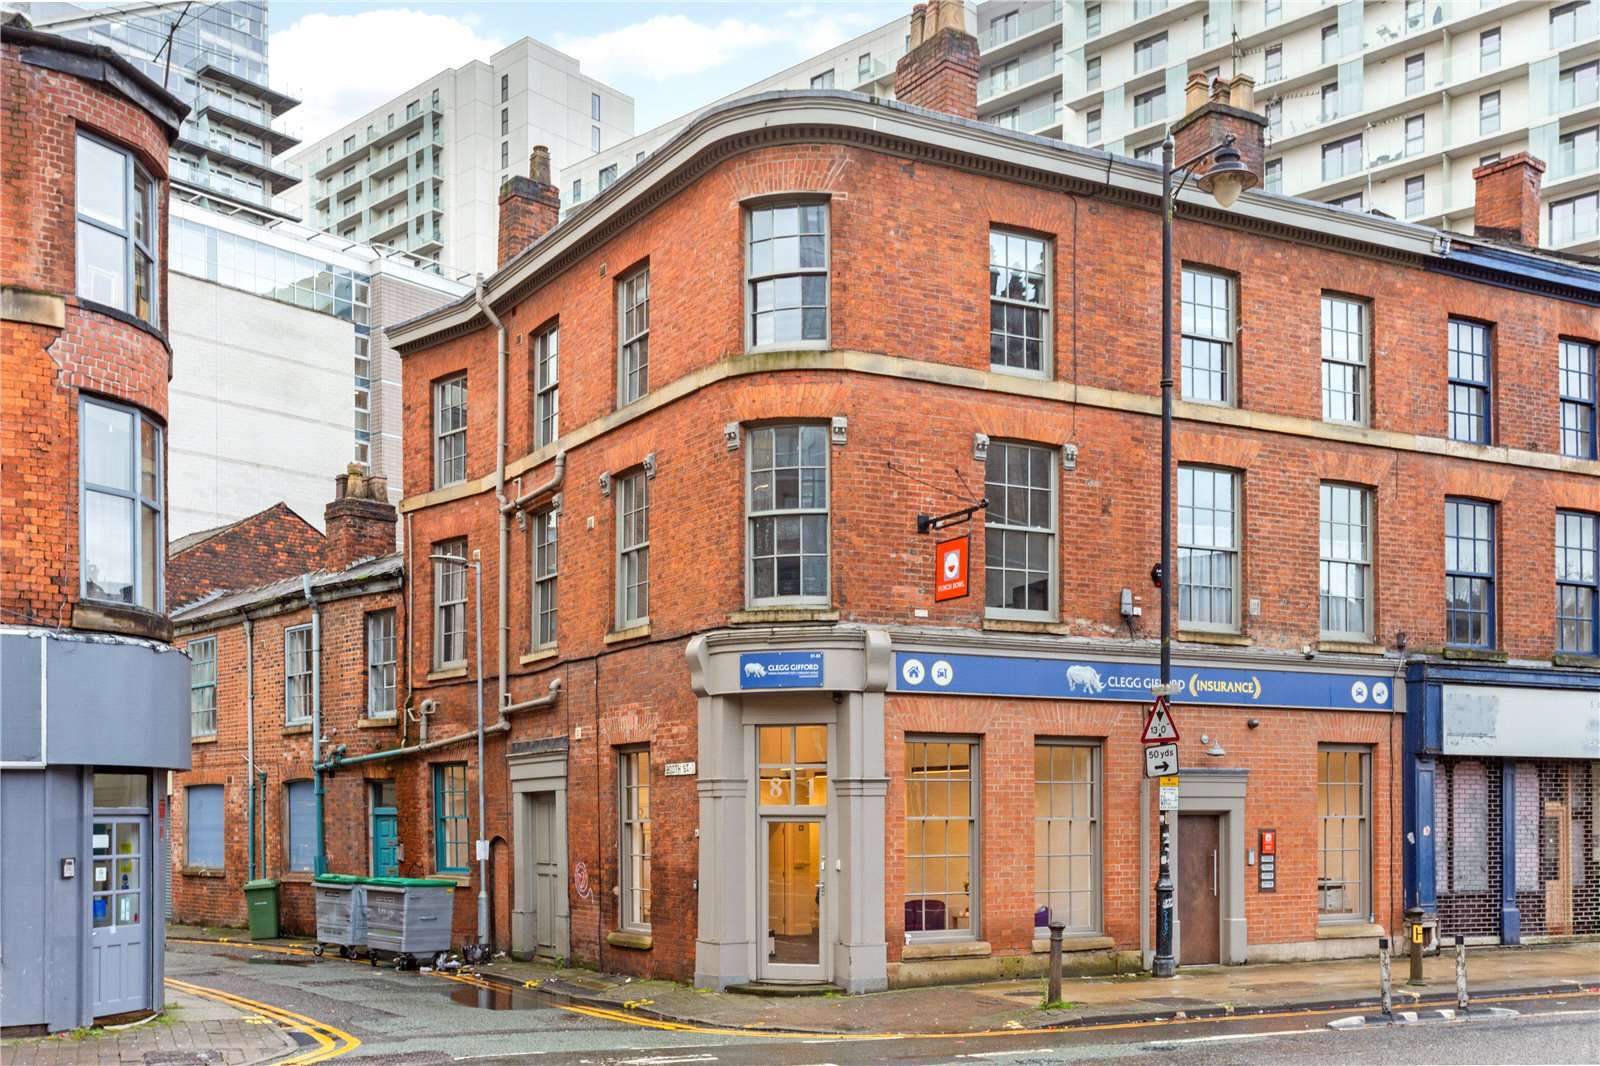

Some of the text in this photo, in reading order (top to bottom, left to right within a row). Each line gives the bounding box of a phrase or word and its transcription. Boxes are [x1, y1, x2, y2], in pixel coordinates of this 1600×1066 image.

[767, 663, 819, 671] CLEGG GIFFORD
[1107, 676, 1142, 689] CLEGG
[1148, 748, 1174, 760] 50 yds
